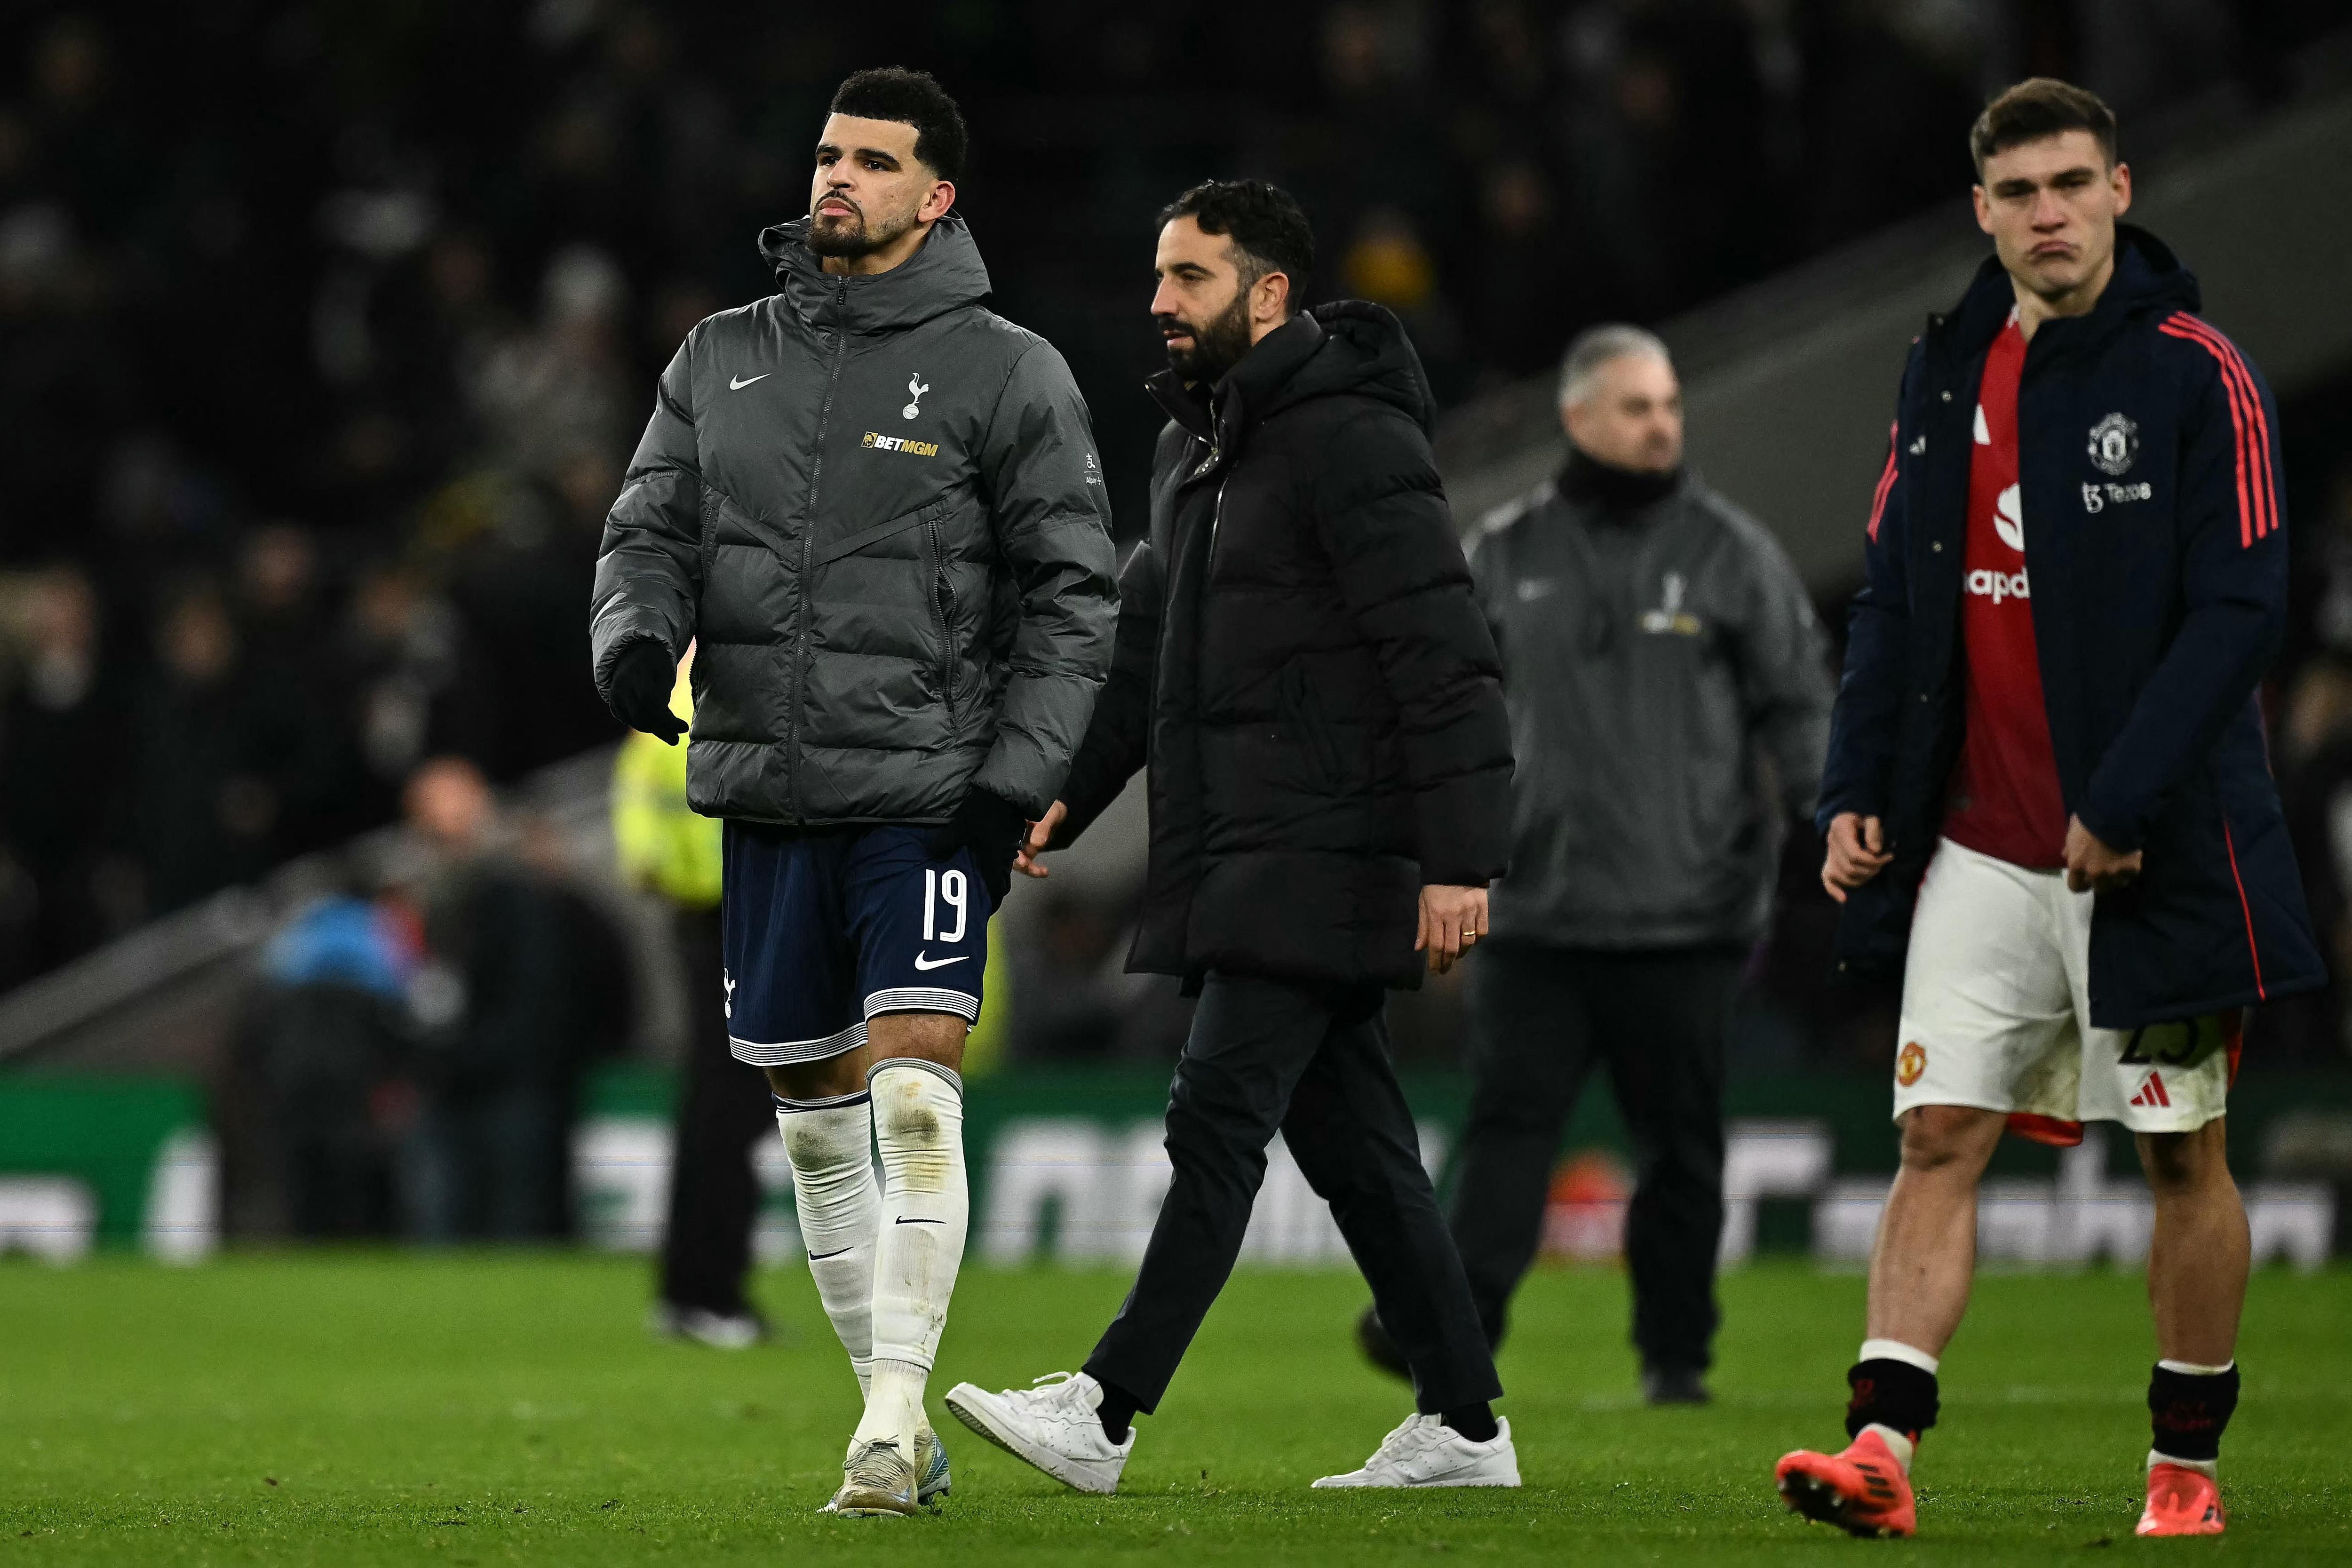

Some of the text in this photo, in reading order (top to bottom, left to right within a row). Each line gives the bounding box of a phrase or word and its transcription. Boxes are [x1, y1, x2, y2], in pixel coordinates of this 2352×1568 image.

[874, 435, 939, 457] BETMGM
[1964, 565, 2030, 605] apd
[922, 868, 968, 943] 19
